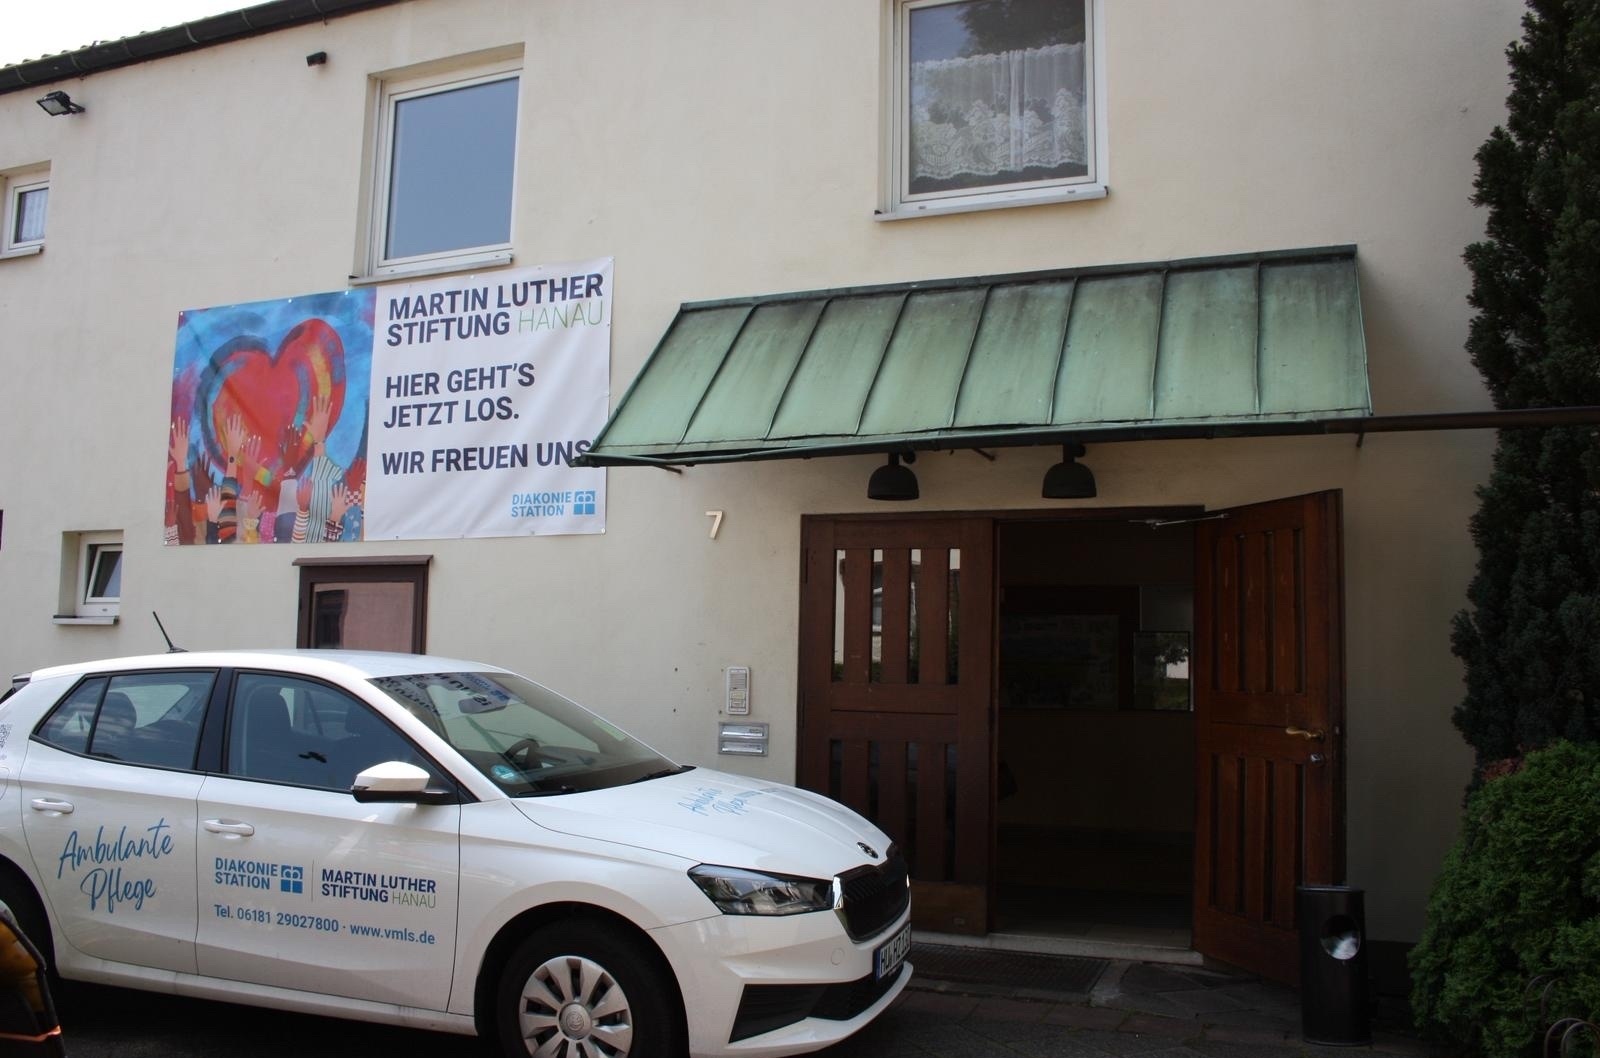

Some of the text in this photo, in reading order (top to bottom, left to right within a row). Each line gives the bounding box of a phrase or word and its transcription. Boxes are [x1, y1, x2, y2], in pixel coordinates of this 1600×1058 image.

[388, 272, 604, 321] MARTIN LUTHER
[386, 301, 603, 347] STIFTUNG HANAU
[385, 362, 535, 398] HIER GEHT'S
[383, 396, 520, 428] JETZT LOS.
[381, 450, 425, 475] WIR
[431, 443, 528, 473] FREUEN
[511, 505, 565, 518] STATION
[512, 491, 572, 506] DIAKONIE
[705, 510, 723, 540] 7
[57, 817, 175, 879] Ambulante
[214, 857, 279, 878] DIAKONIE
[214, 871, 271, 891] STATION
[321, 868, 437, 894] MARTIN LUTHER
[79, 868, 158, 914] Pflege
[321, 882, 436, 909] STIFTUNG HANAU
[214, 904, 436, 946] Tel. 06181 29027800 www.vmls.de
